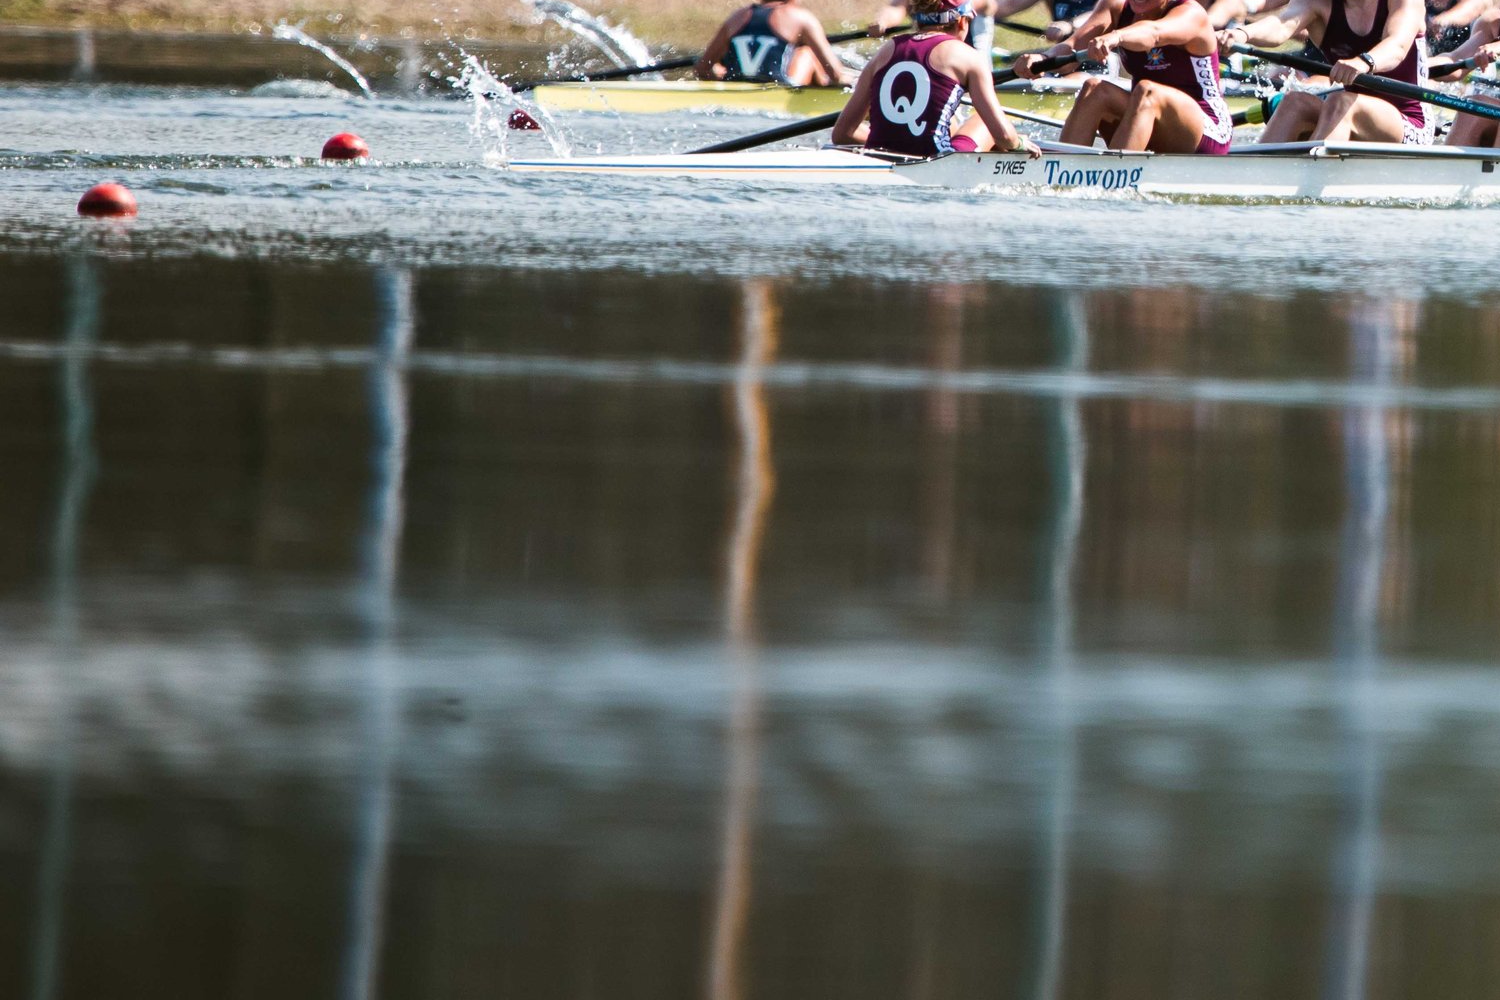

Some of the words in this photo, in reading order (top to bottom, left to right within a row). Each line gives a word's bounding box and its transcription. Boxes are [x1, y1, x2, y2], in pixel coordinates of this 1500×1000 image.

[732, 34, 779, 77] V
[880, 61, 931, 136] Q
[993, 160, 1026, 175] SYKES
[1044, 160, 1143, 191] Toowong
